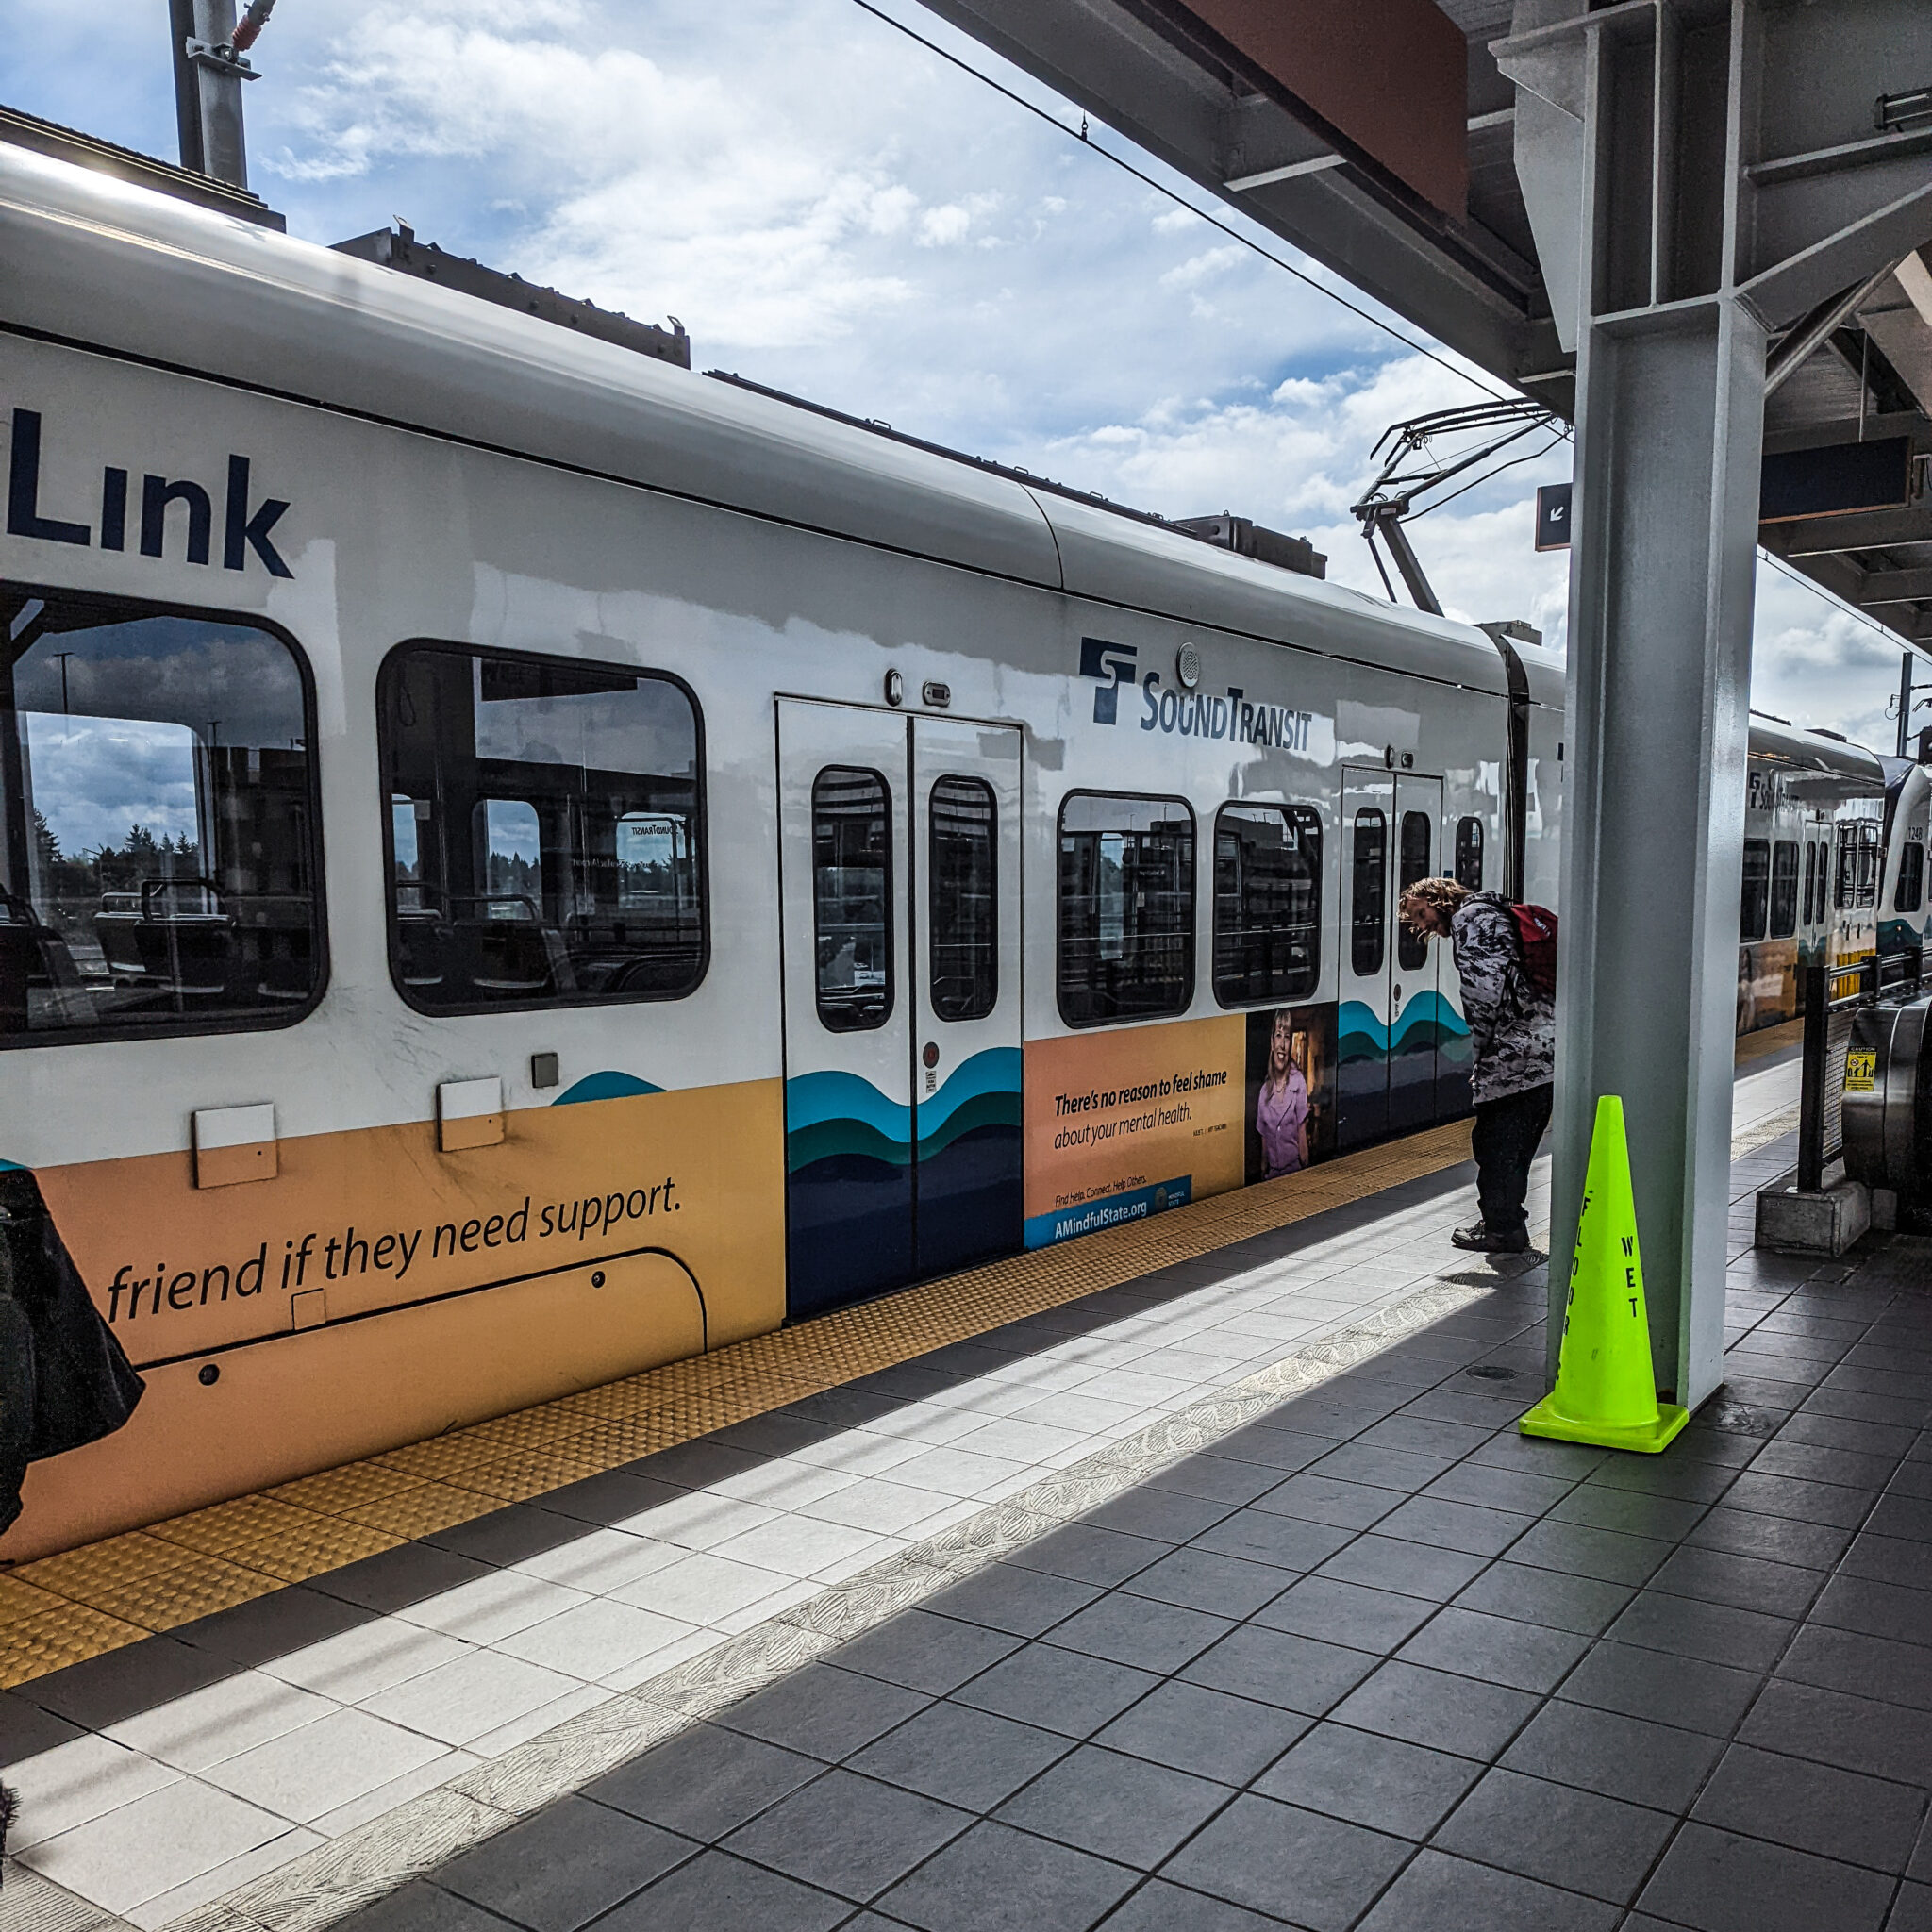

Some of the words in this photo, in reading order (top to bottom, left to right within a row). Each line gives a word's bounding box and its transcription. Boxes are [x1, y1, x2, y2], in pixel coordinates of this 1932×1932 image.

[7, 408, 294, 579] Link
[1055, 1090, 1098, 1116] There's
[1101, 1091, 1117, 1108] no
[1118, 1085, 1158, 1104] reason
[1159, 1078, 1171, 1097] to
[1172, 1072, 1193, 1092] feel
[1193, 1070, 1227, 1088] shame
[1054, 1122, 1090, 1149] about
[1091, 1122, 1118, 1147] your
[1119, 1109, 1157, 1133] mental
[1158, 1101, 1192, 1126] health.
[1055, 1192, 1069, 1208] Find
[1113, 1179, 1126, 1191] Help
[1055, 1201, 1148, 1239] AMindfulState.org
[108, 1243, 268, 1324] friend
[281, 1232, 318, 1289] if
[325, 1226, 422, 1281] they
[433, 1197, 531, 1259] need
[540, 1176, 682, 1241] support.
[1621, 1236, 1639, 1318] WET
